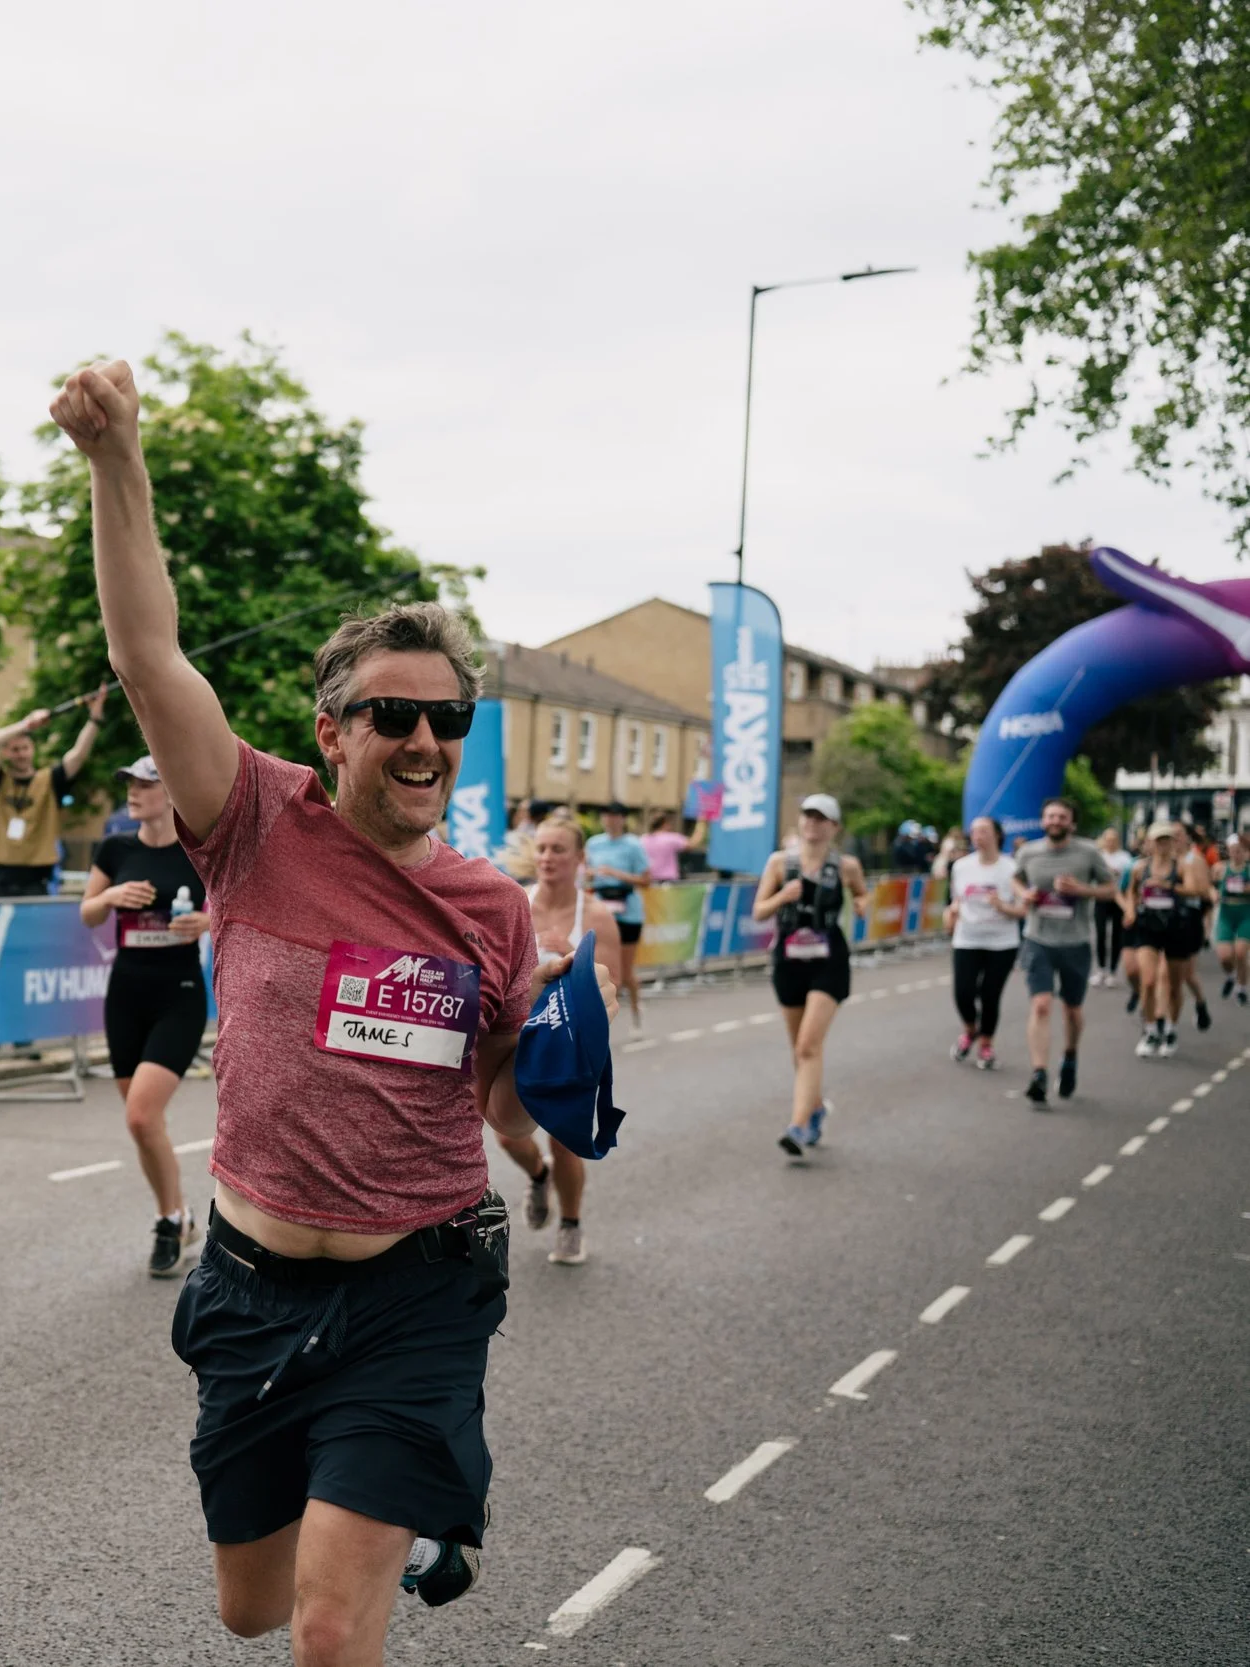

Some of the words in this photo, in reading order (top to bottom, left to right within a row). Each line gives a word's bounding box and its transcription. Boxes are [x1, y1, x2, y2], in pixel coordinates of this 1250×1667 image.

[24, 967, 58, 1005] FLY
[377, 984, 395, 1009] E
[401, 988, 465, 1020] 15787
[343, 1020, 414, 1048] JAMES
